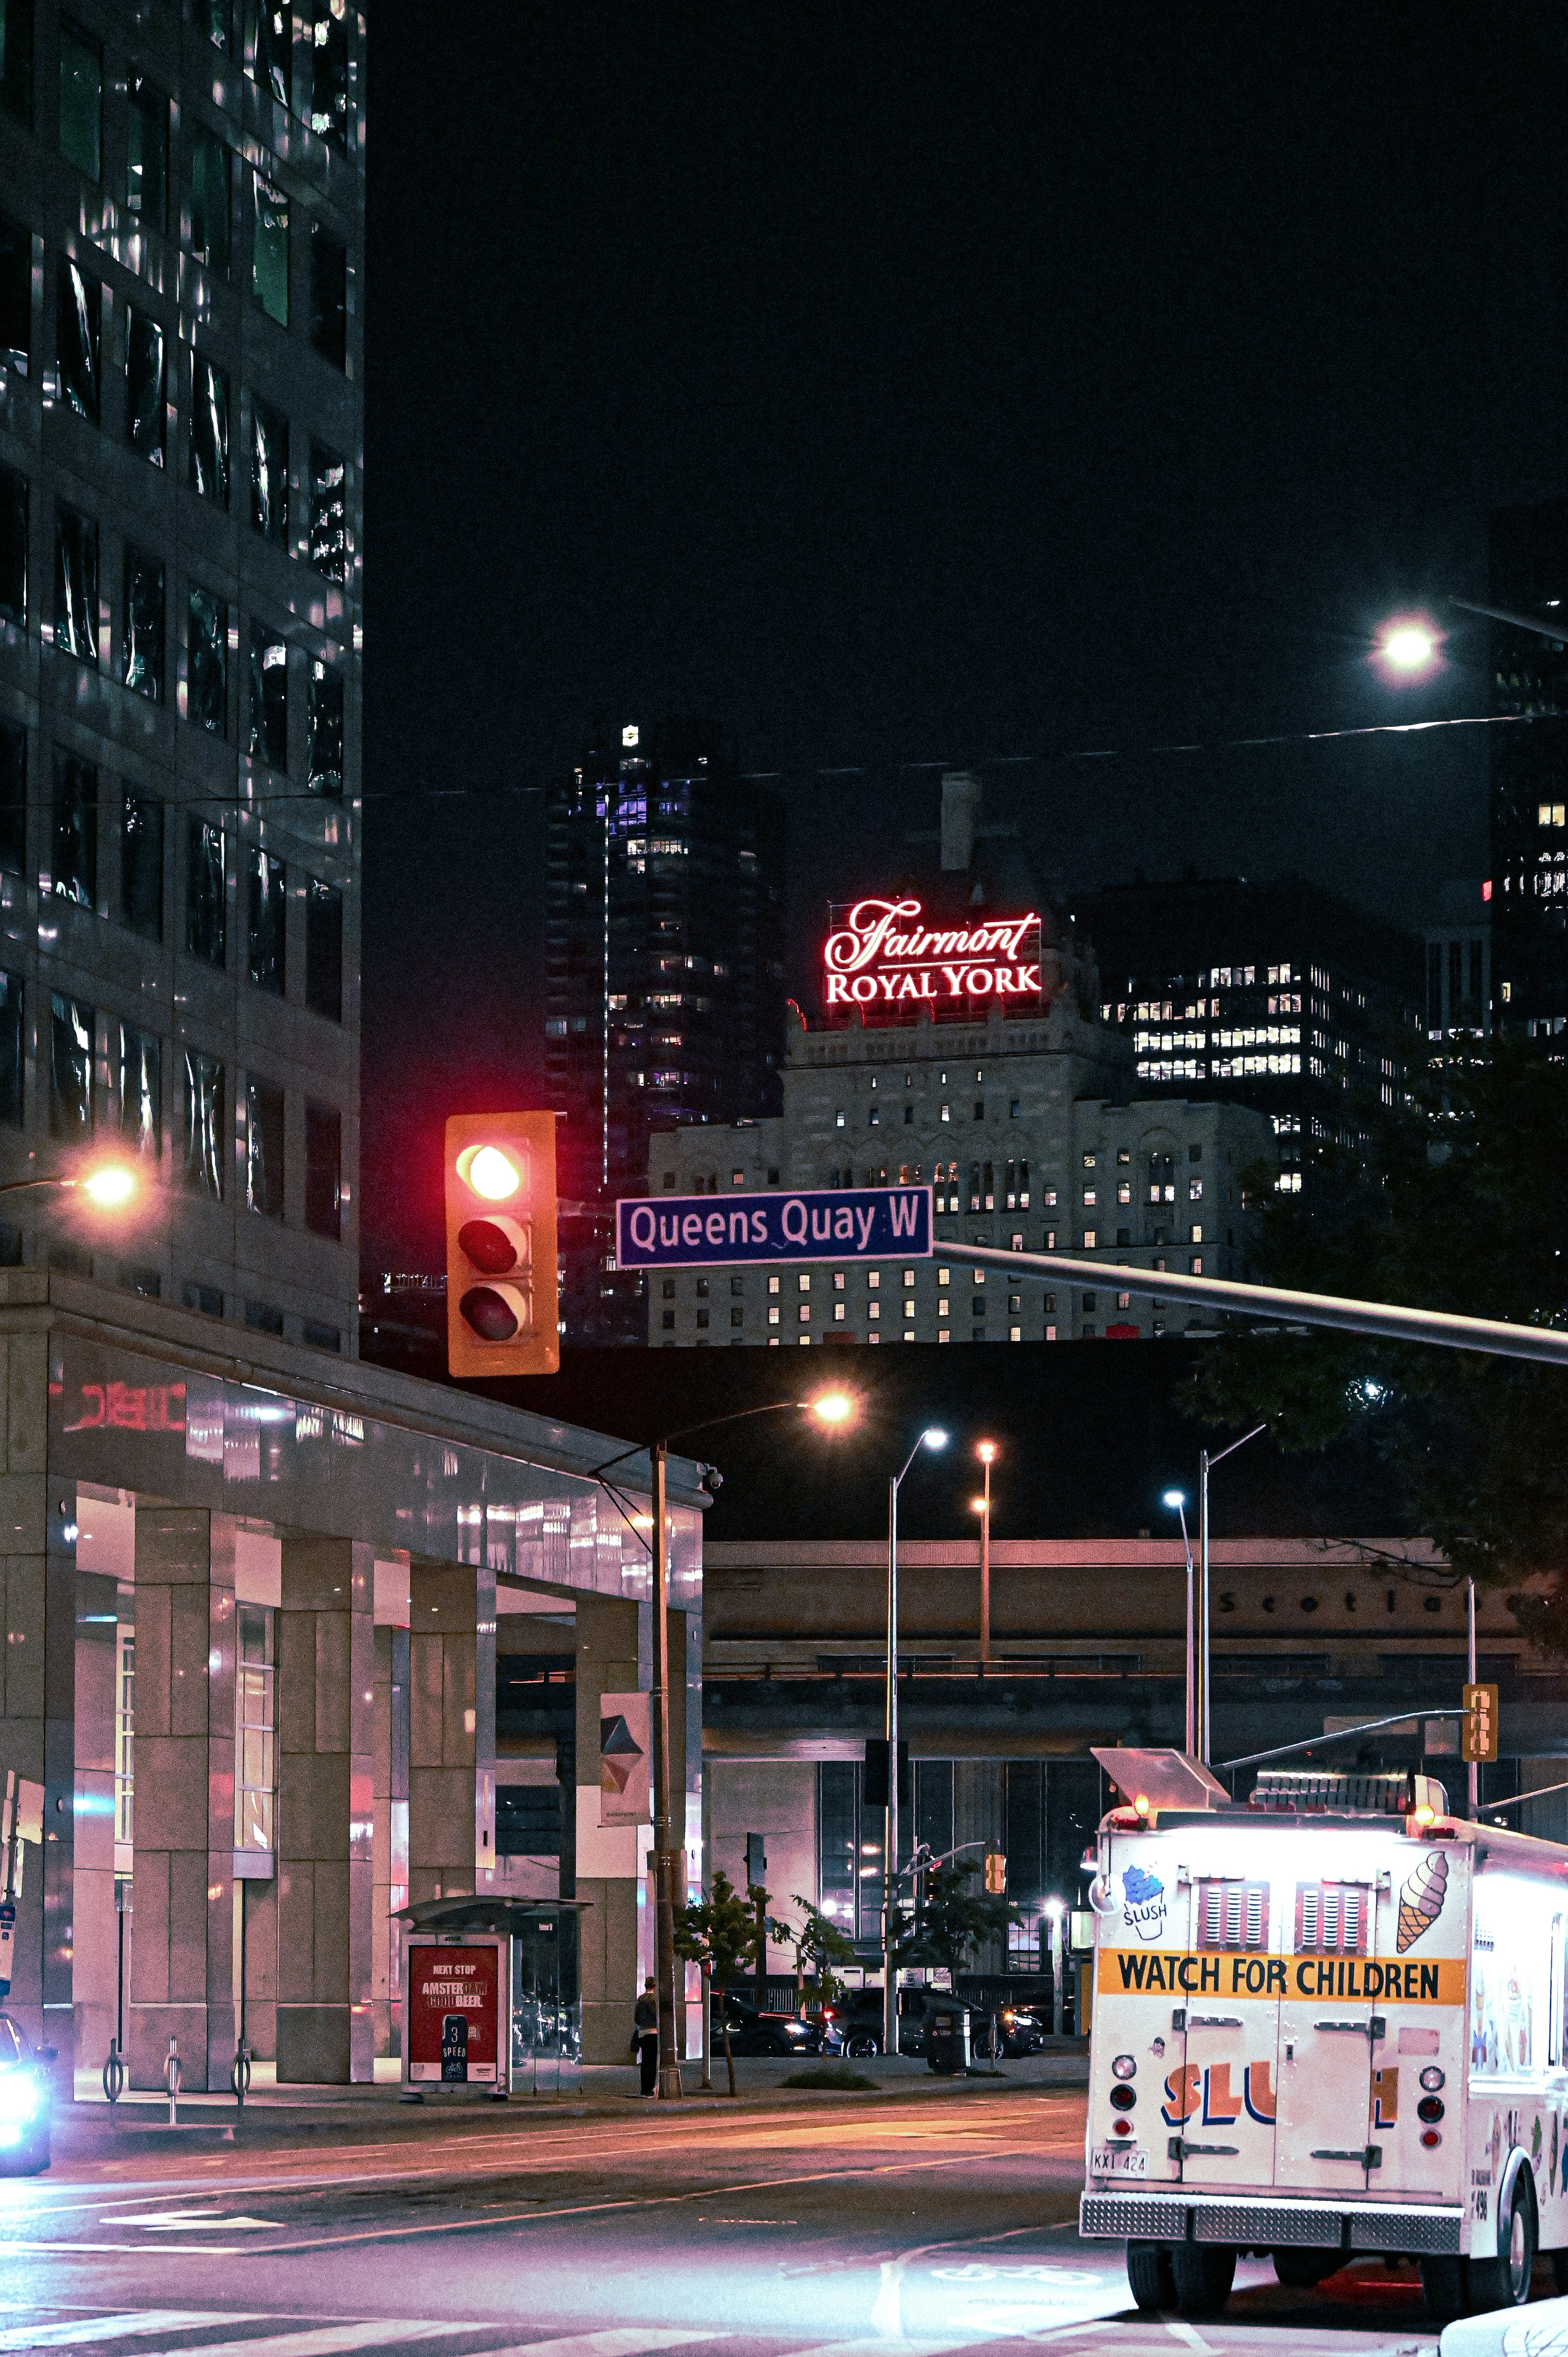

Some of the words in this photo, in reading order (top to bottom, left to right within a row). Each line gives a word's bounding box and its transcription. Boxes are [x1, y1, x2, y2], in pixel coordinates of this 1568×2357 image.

[825, 899, 1042, 972] Fairmont
[826, 972, 938, 1003] ROYAL
[941, 965, 1042, 995] YORK
[630, 1206, 768, 1252] Queens
[781, 1199, 875, 1251] Quay
[889, 1195, 919, 1237] W
[1124, 1903, 1168, 1927] SLUSH
[433, 1965, 453, 1975] NEXT
[454, 1965, 476, 1975] STOP
[1117, 1954, 1220, 1992] WATCH
[1232, 1958, 1287, 1995] FOR
[1295, 1960, 1439, 1999] CHILDREN
[451, 2027, 458, 2042] 3
[443, 2047, 466, 2057] SPEED
